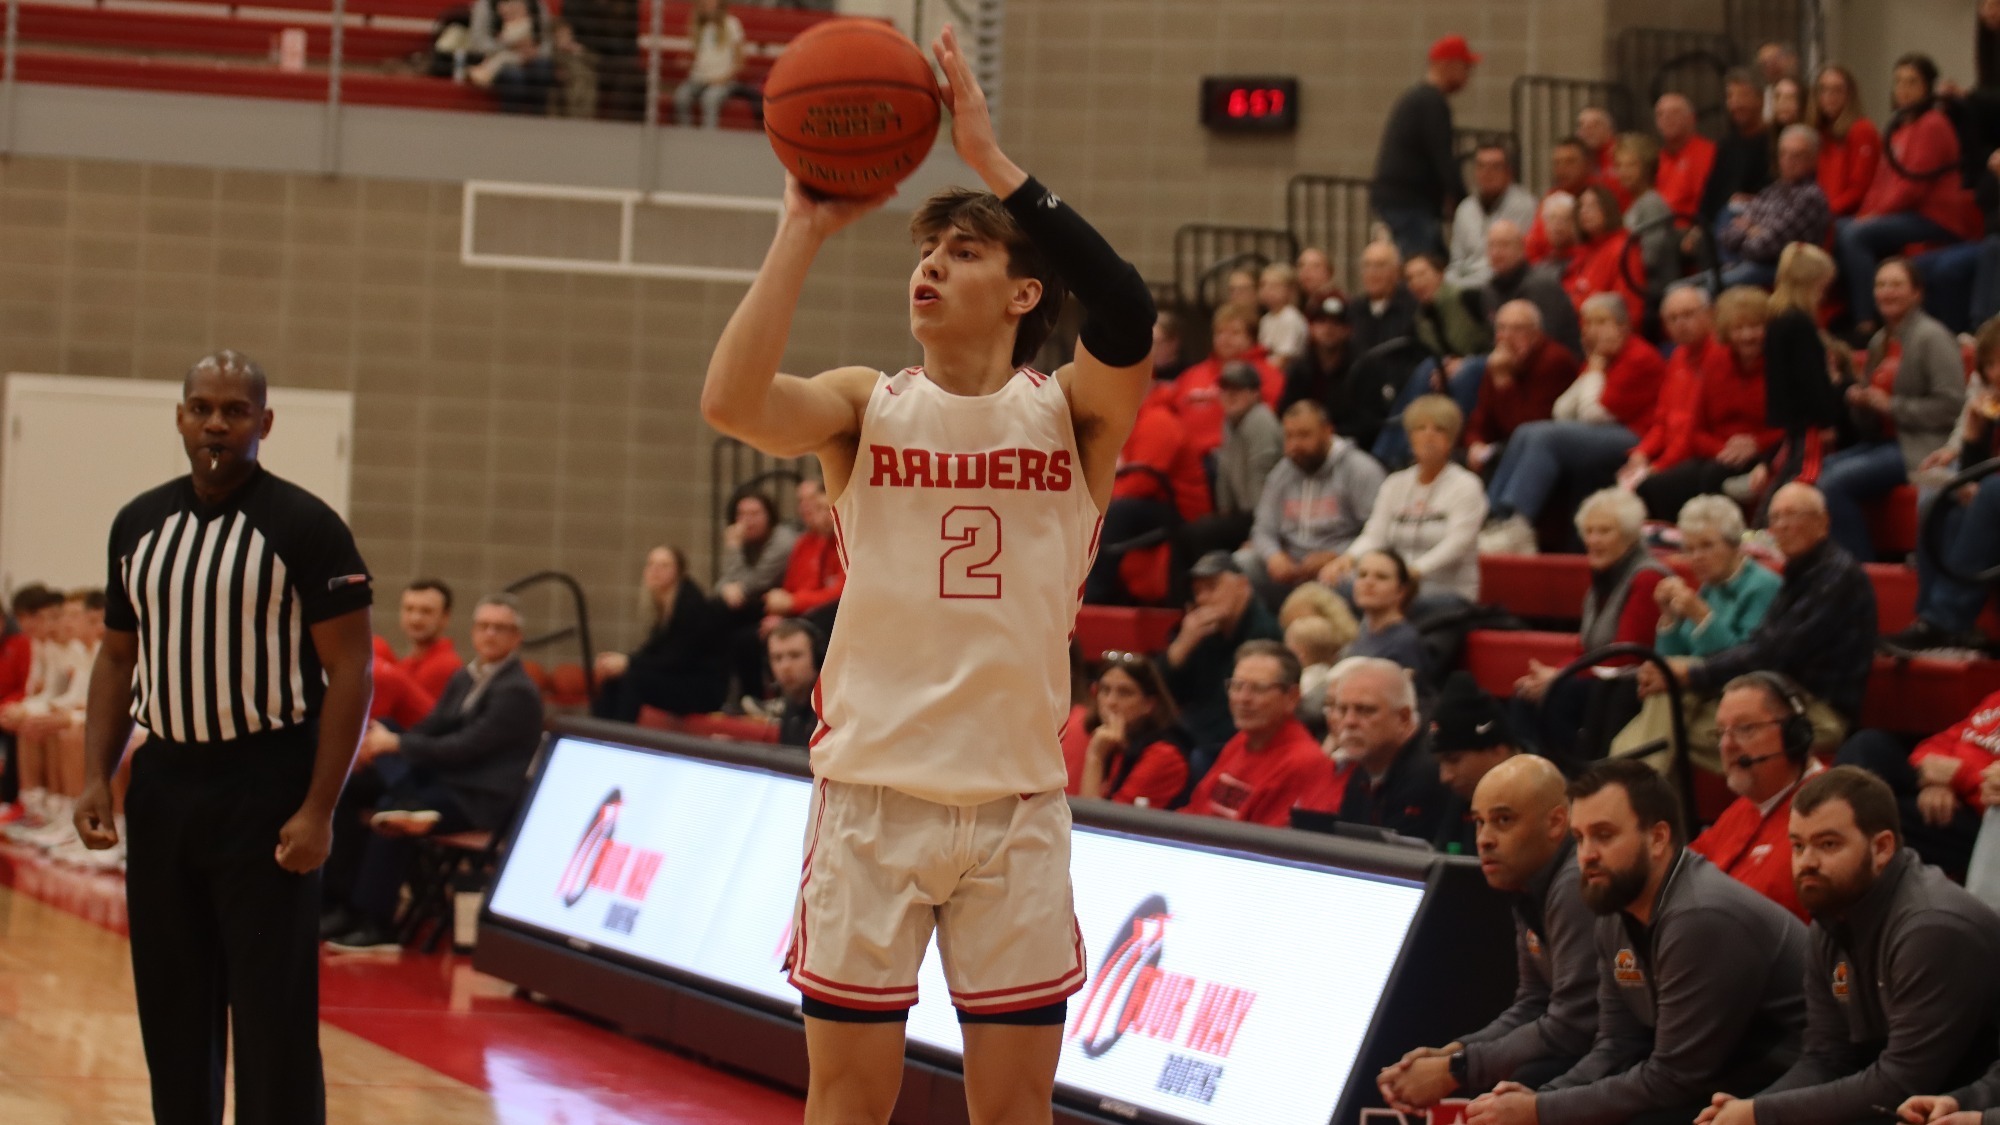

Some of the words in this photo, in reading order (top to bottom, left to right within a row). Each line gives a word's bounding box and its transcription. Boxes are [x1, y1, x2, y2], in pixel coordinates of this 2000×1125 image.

[869, 444, 1072, 492] RAIDERS
[939, 505, 1002, 600] 2
[1186, 983, 1258, 1057] WAY
